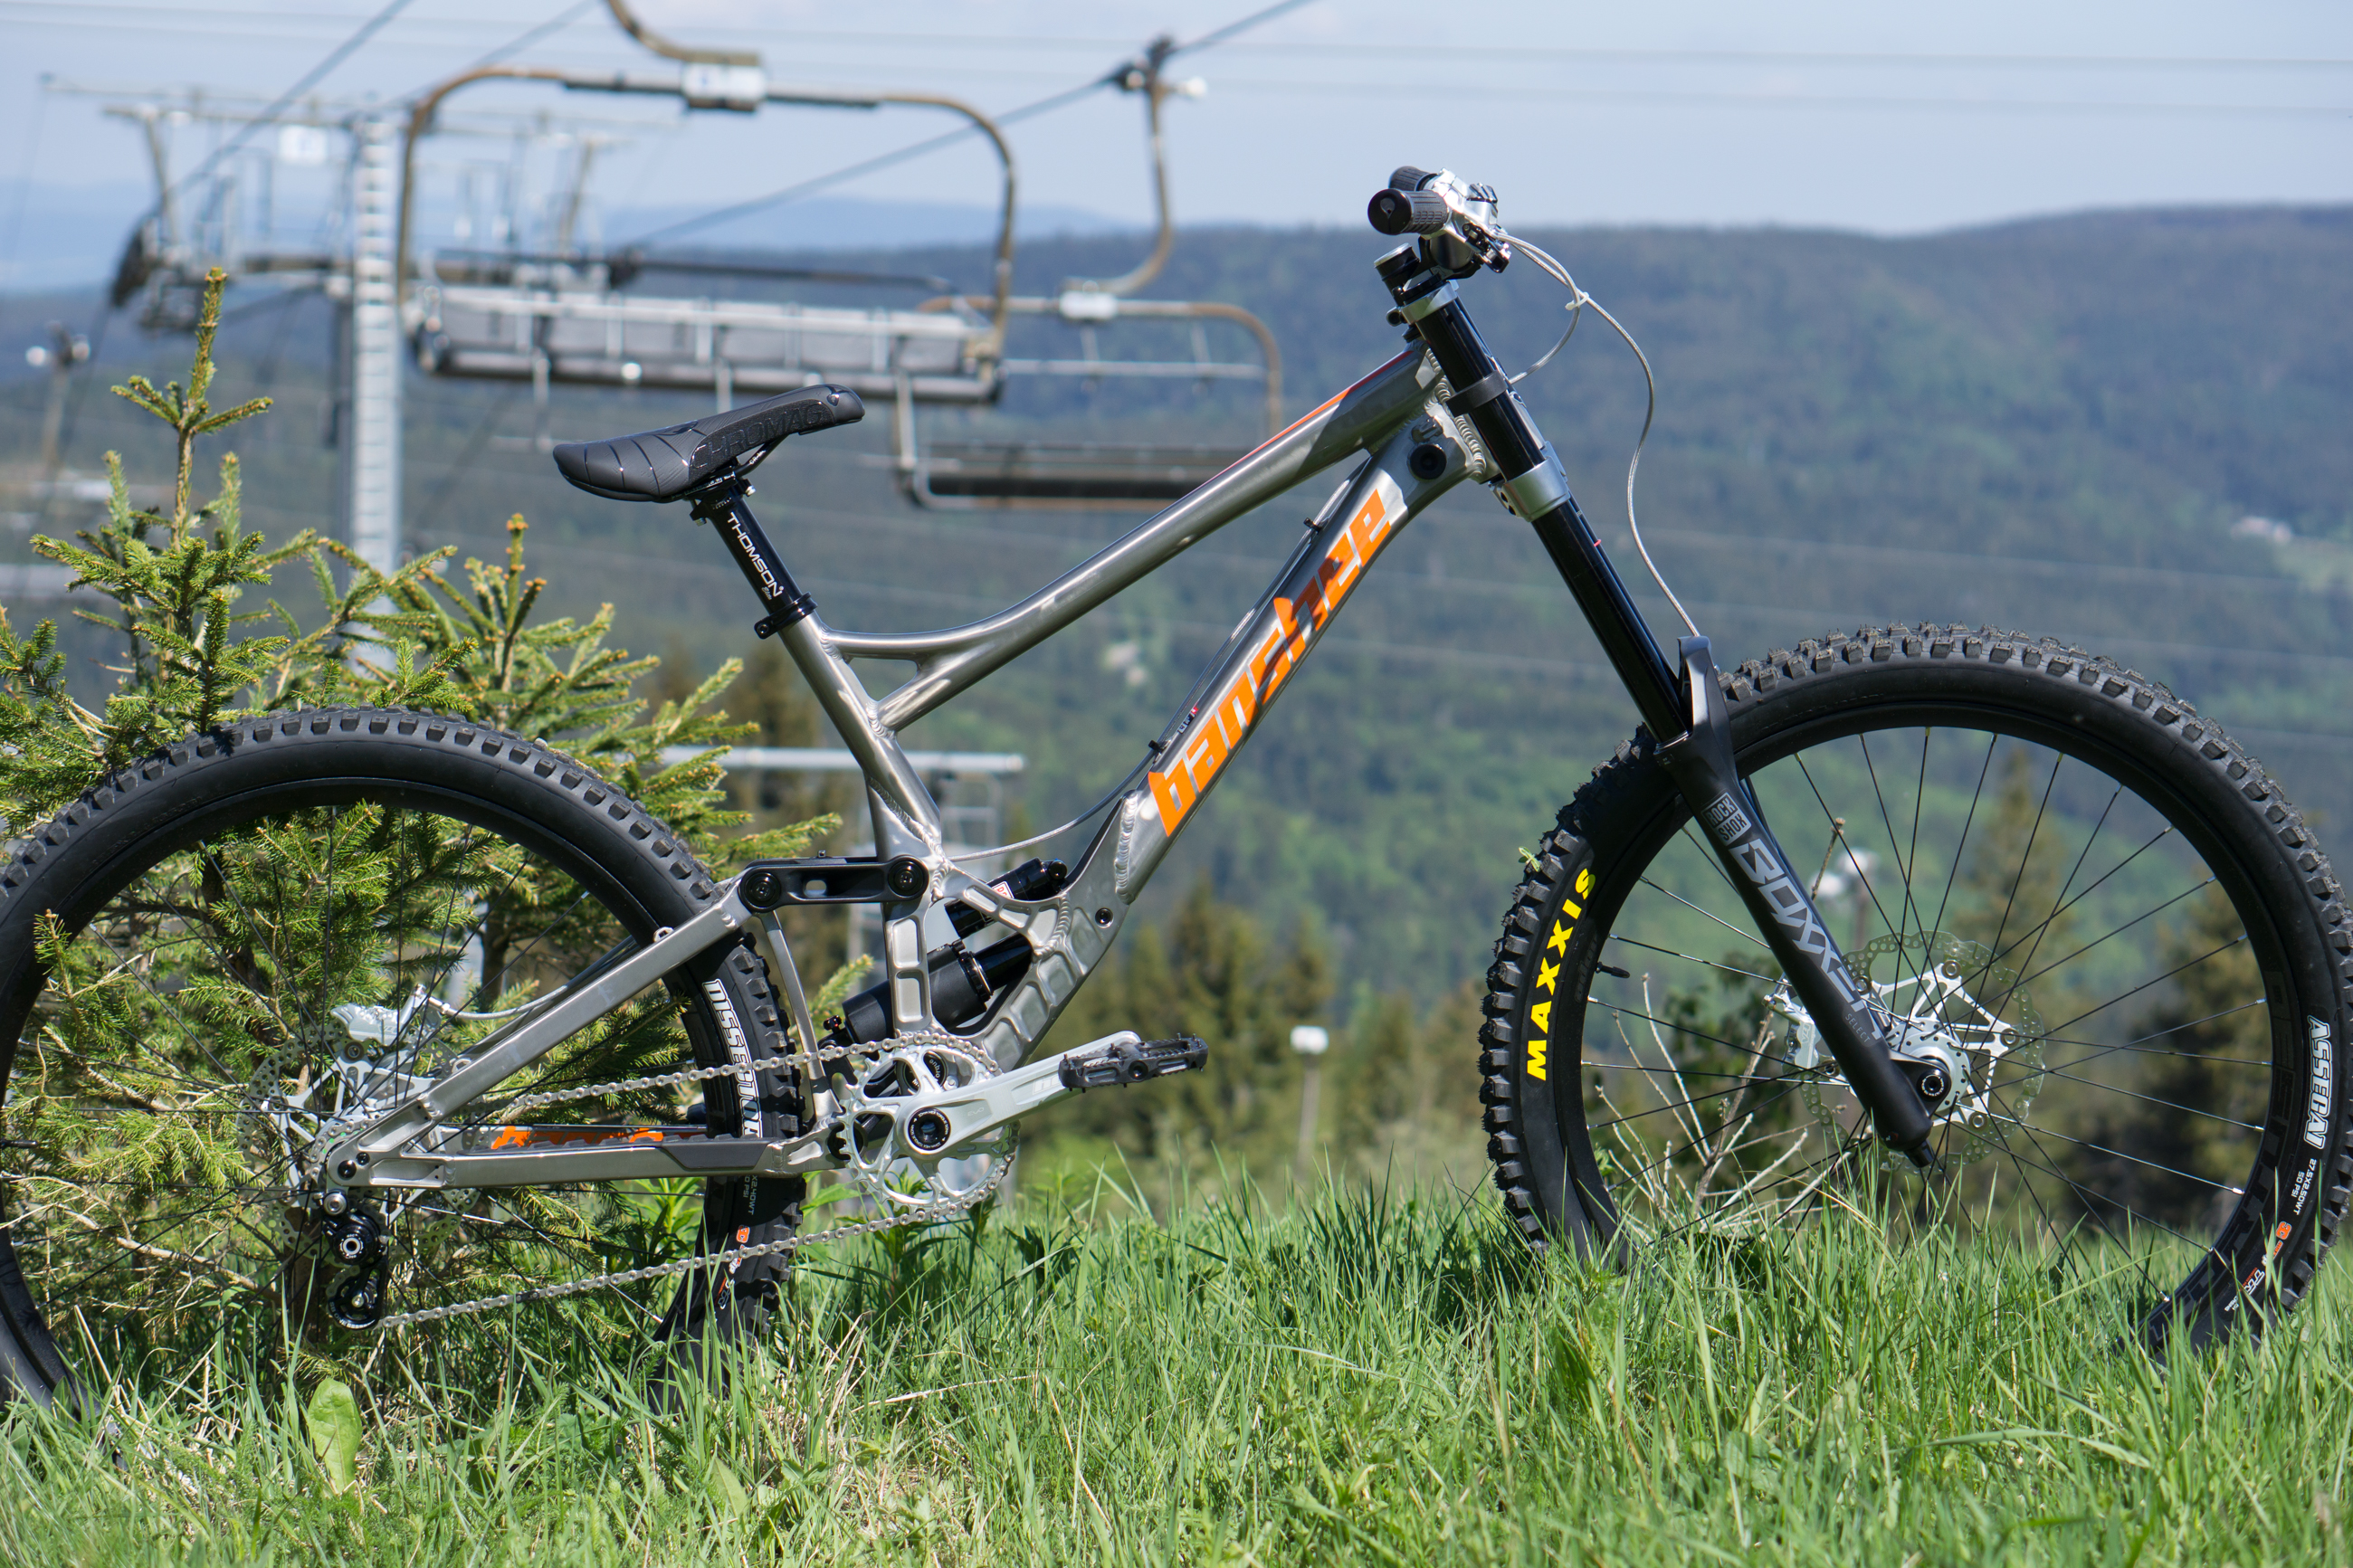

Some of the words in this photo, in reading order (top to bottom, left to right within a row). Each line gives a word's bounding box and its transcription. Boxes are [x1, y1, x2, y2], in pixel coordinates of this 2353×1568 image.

[728, 511, 784, 597] THOMSON
[1704, 797, 1736, 826] ROCK
[1717, 813, 1748, 841] SHOX
[1527, 869, 1596, 1080] MAXXIS
[1844, 1012, 1871, 1043] SELECT
[2303, 1014, 2332, 1150] ASSEGAI
[2291, 1183, 2301, 1197] PSI
[2294, 1159, 2317, 1215] 27.5X2.50WT
[2295, 1171, 2304, 1183] 50
[748, 1174, 757, 1215] X2.40WT
[2275, 1221, 2292, 1240] 3C
